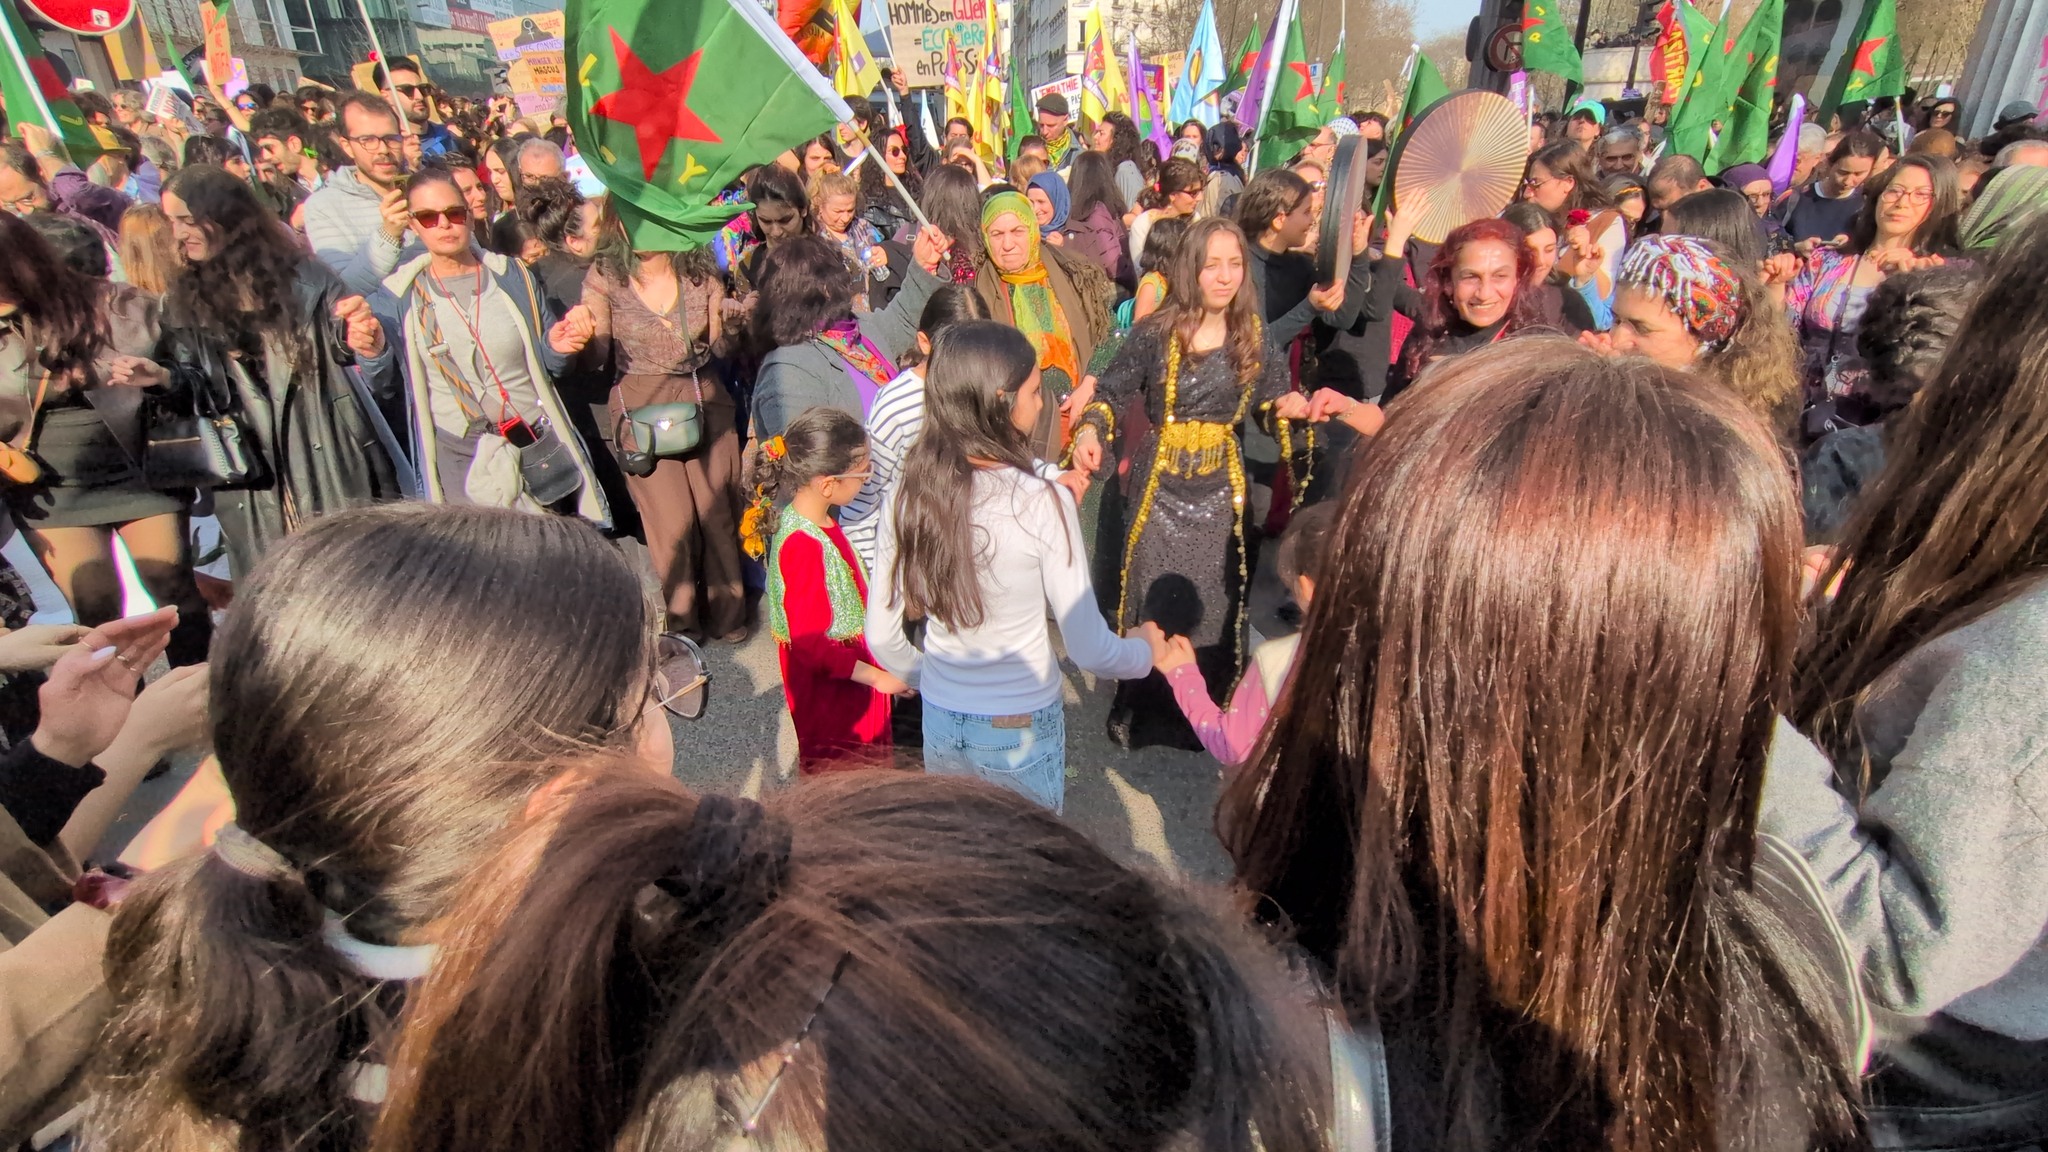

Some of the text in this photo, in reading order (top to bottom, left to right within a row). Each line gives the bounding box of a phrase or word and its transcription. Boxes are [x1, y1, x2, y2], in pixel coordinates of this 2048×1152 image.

[940, 11, 954, 22] en
[953, 0, 987, 21] GUeR
[917, 59, 931, 76] en
